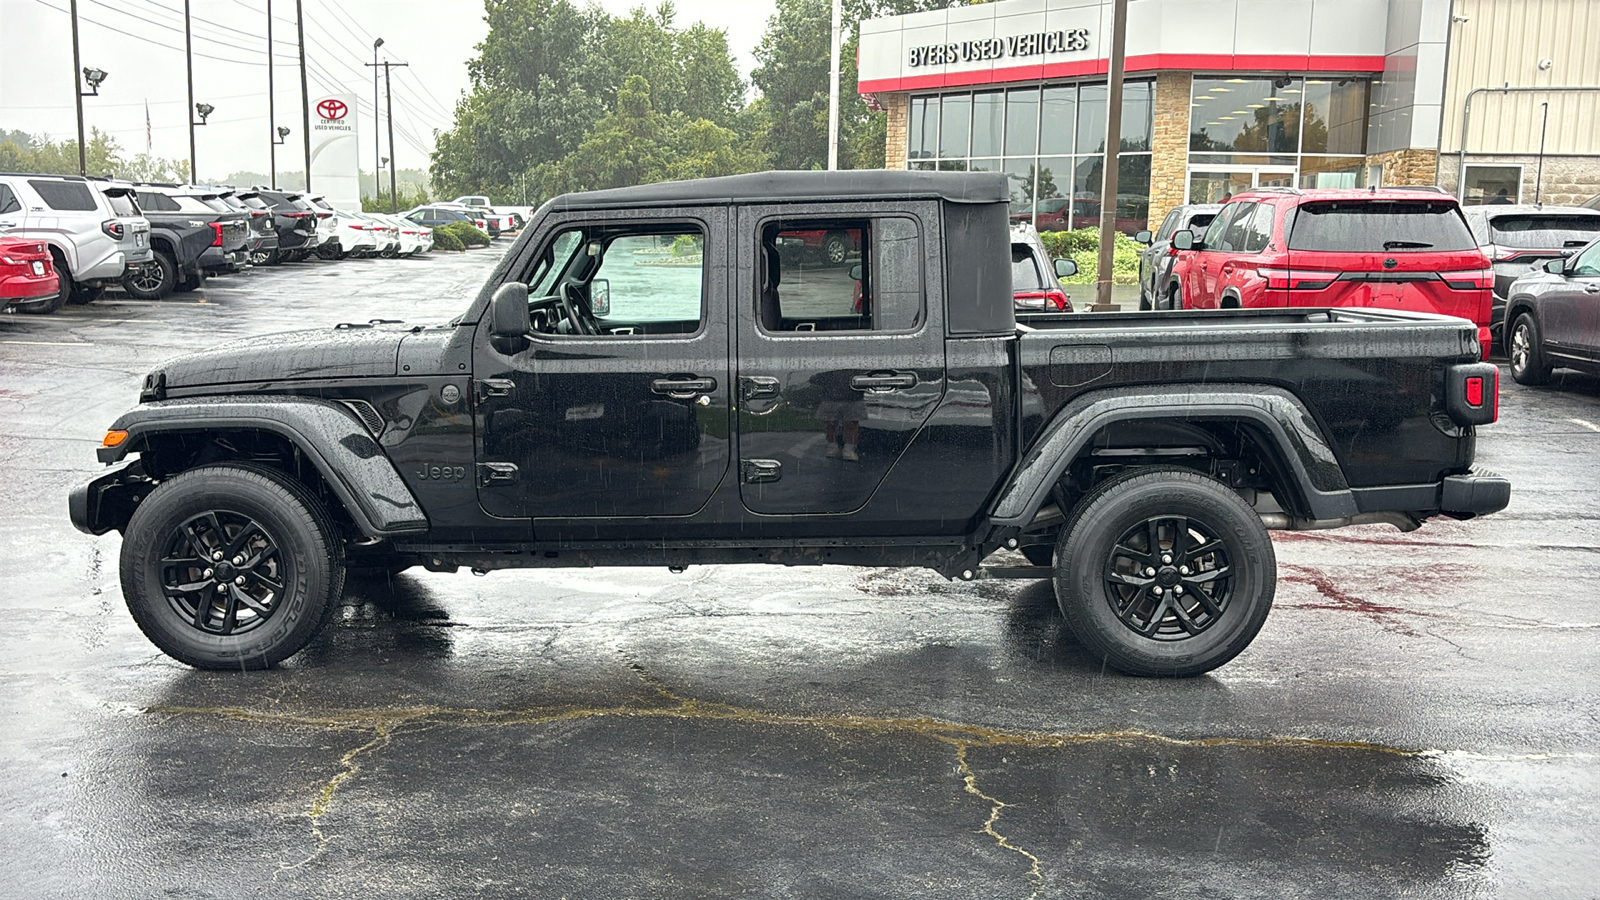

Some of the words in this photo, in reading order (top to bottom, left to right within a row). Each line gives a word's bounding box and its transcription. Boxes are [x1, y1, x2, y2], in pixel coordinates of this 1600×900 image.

[908, 42, 957, 67] BYERS
[960, 37, 1004, 63] USED
[1006, 28, 1089, 57] VEHICLES
[416, 462, 465, 483] Jeep
